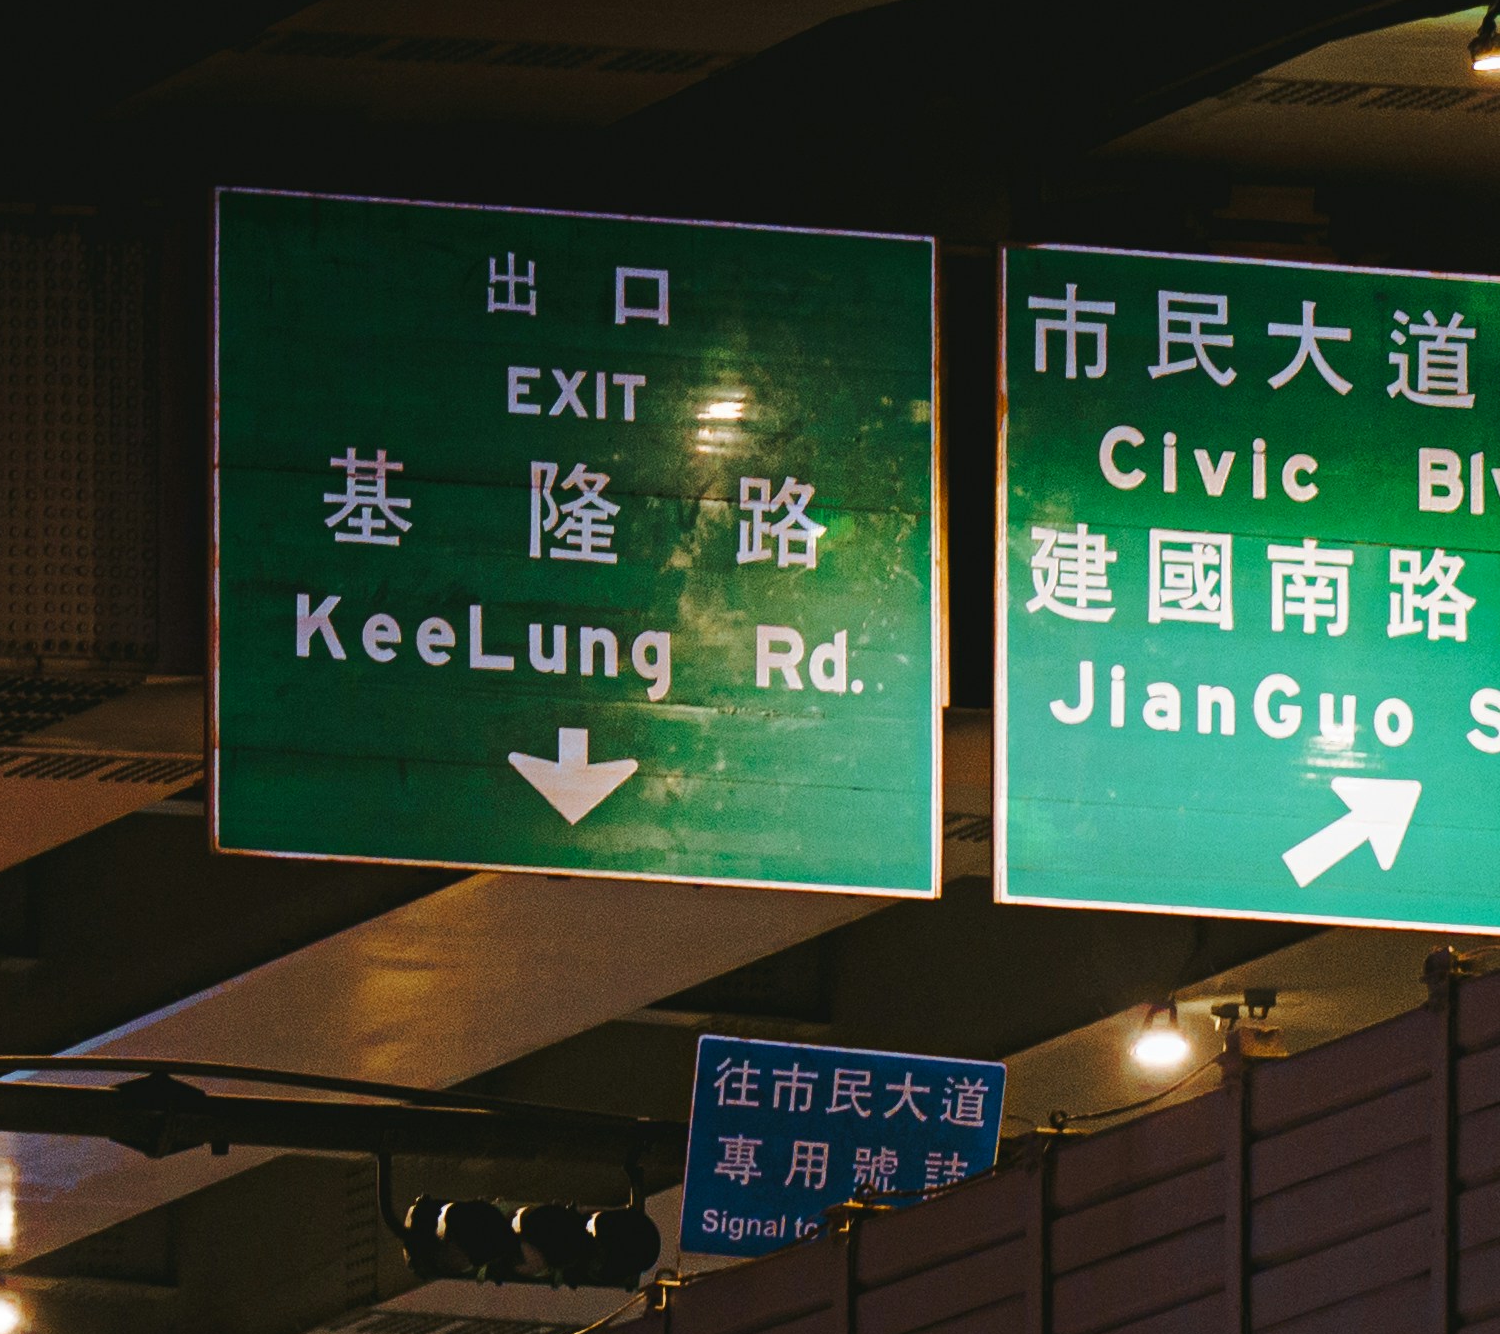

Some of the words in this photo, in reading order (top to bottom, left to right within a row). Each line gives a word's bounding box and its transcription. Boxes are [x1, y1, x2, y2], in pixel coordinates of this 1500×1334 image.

[486, 252, 670, 325] 出口
[1027, 283, 1476, 409] 市民大道
[507, 366, 647, 422] EXIT
[1099, 424, 1319, 502] Civic
[322, 447, 828, 569] 基隆路
[1026, 523, 1476, 643] 建國南路
[295, 593, 673, 701] KeeLung
[755, 624, 865, 695] Rd.
[1049, 660, 1414, 748] JianGuo
[713, 1057, 989, 1128] 往市民大道
[702, 1209, 786, 1241] Signal
